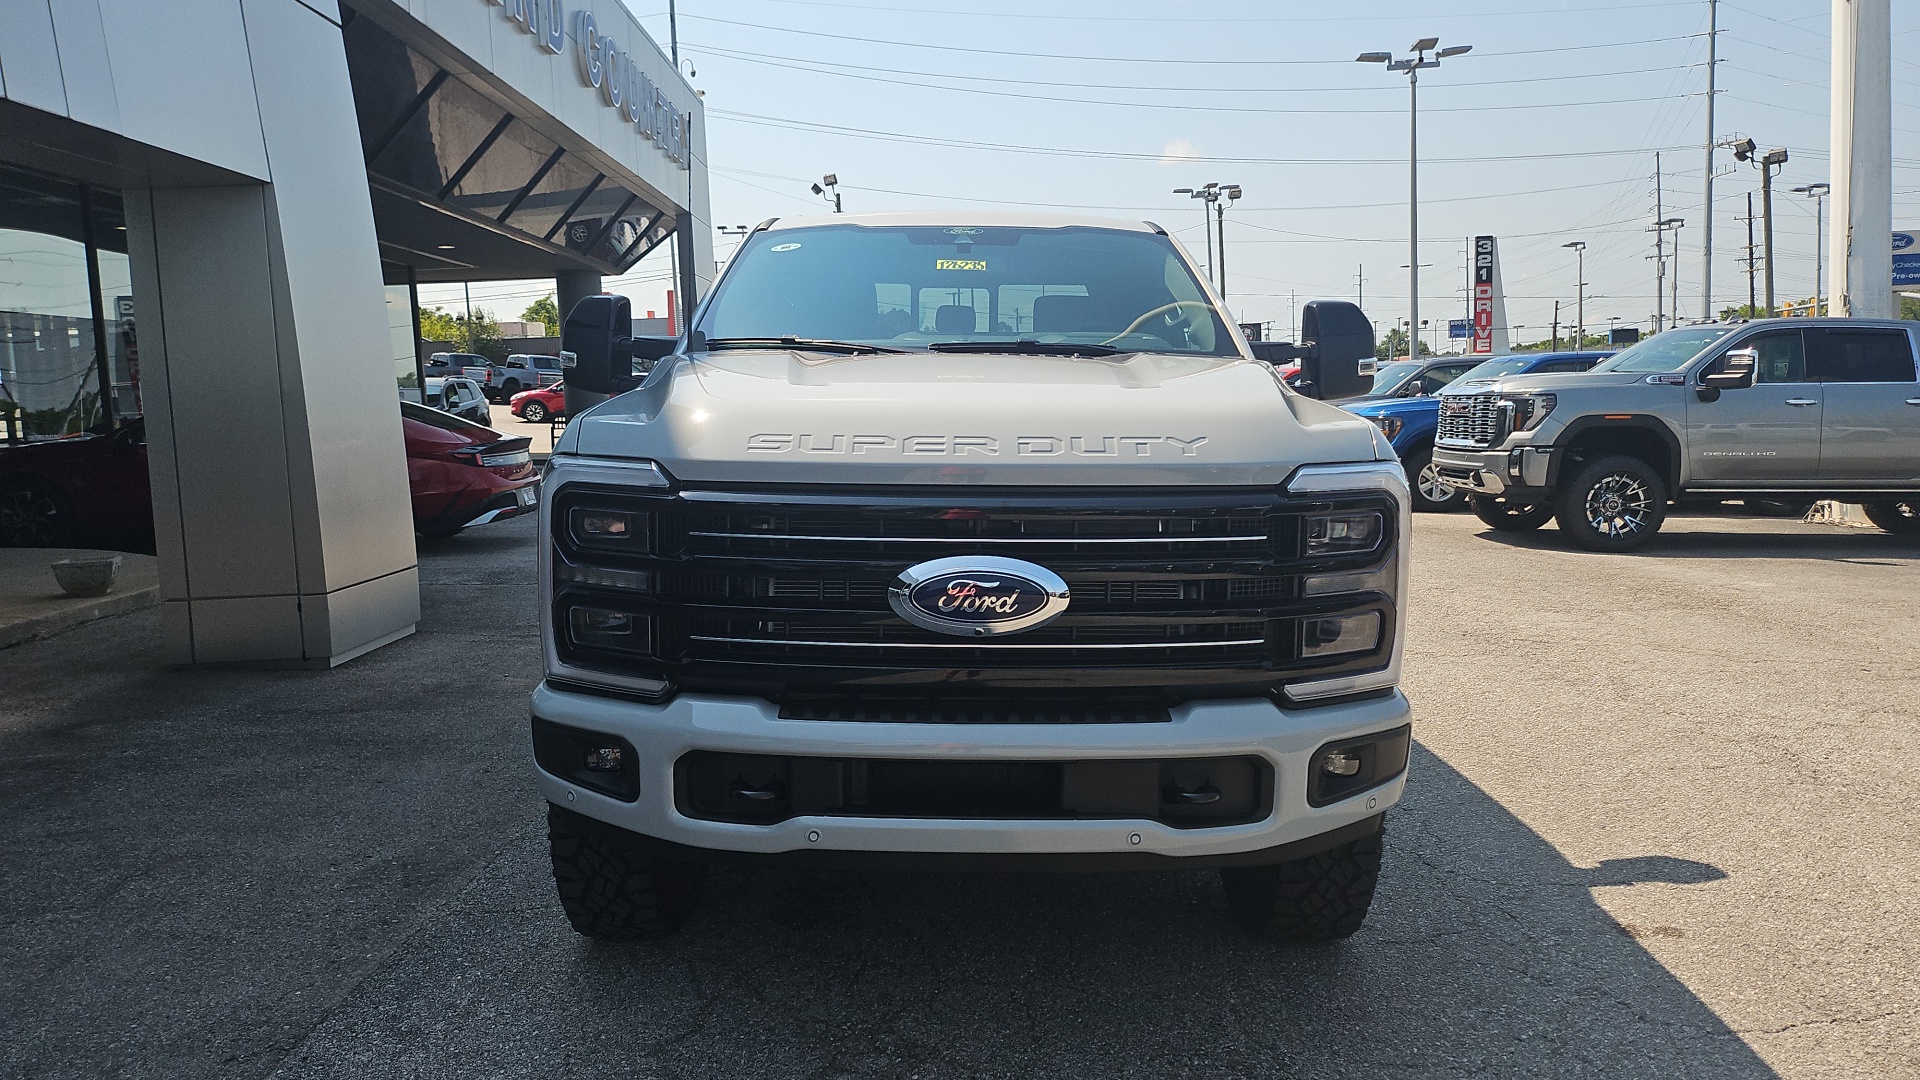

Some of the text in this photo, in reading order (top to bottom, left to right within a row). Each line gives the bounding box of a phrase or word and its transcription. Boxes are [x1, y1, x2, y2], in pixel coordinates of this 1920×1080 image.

[1477, 240, 1492, 280] 321
[1475, 286, 1492, 351] DRIVE
[747, 433, 1208, 456] SUPER DUTY
[937, 579, 1021, 613] Ford
